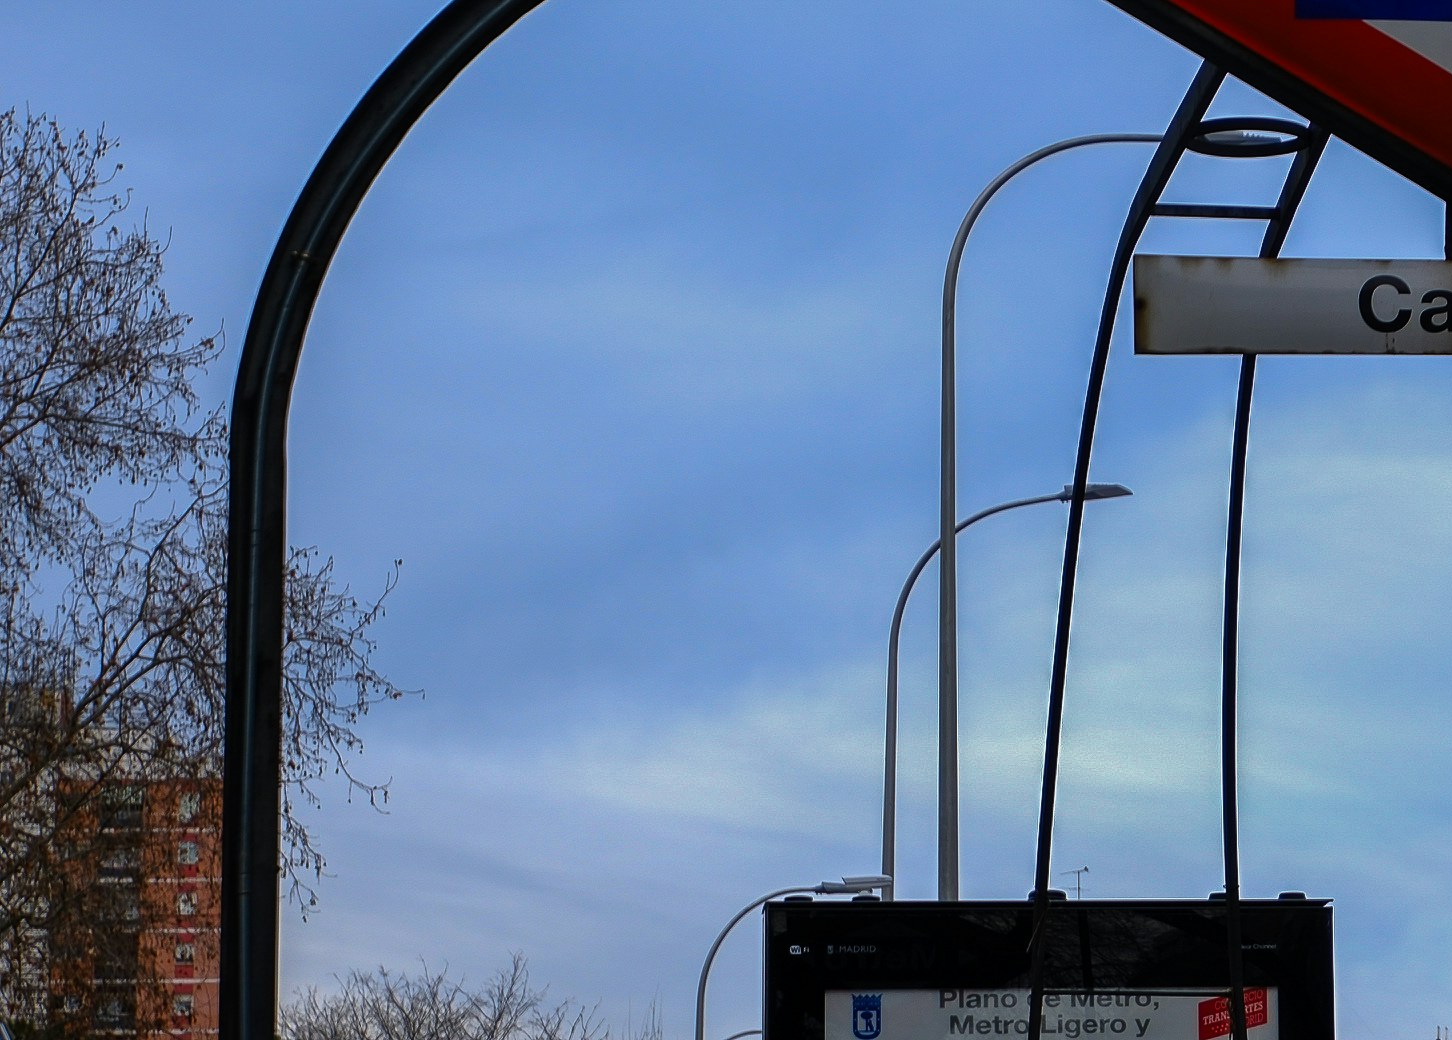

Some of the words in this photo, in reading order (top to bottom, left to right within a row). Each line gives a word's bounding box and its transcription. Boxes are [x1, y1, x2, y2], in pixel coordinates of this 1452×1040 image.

[839, 945, 877, 953] MADRID
[939, 988, 1018, 1009] Plano
[1026, 993, 1061, 1008] e
[949, 1014, 1030, 1035] Metro
[1040, 1014, 1127, 1039] Ligero
[1135, 1017, 1151, 1038] y
